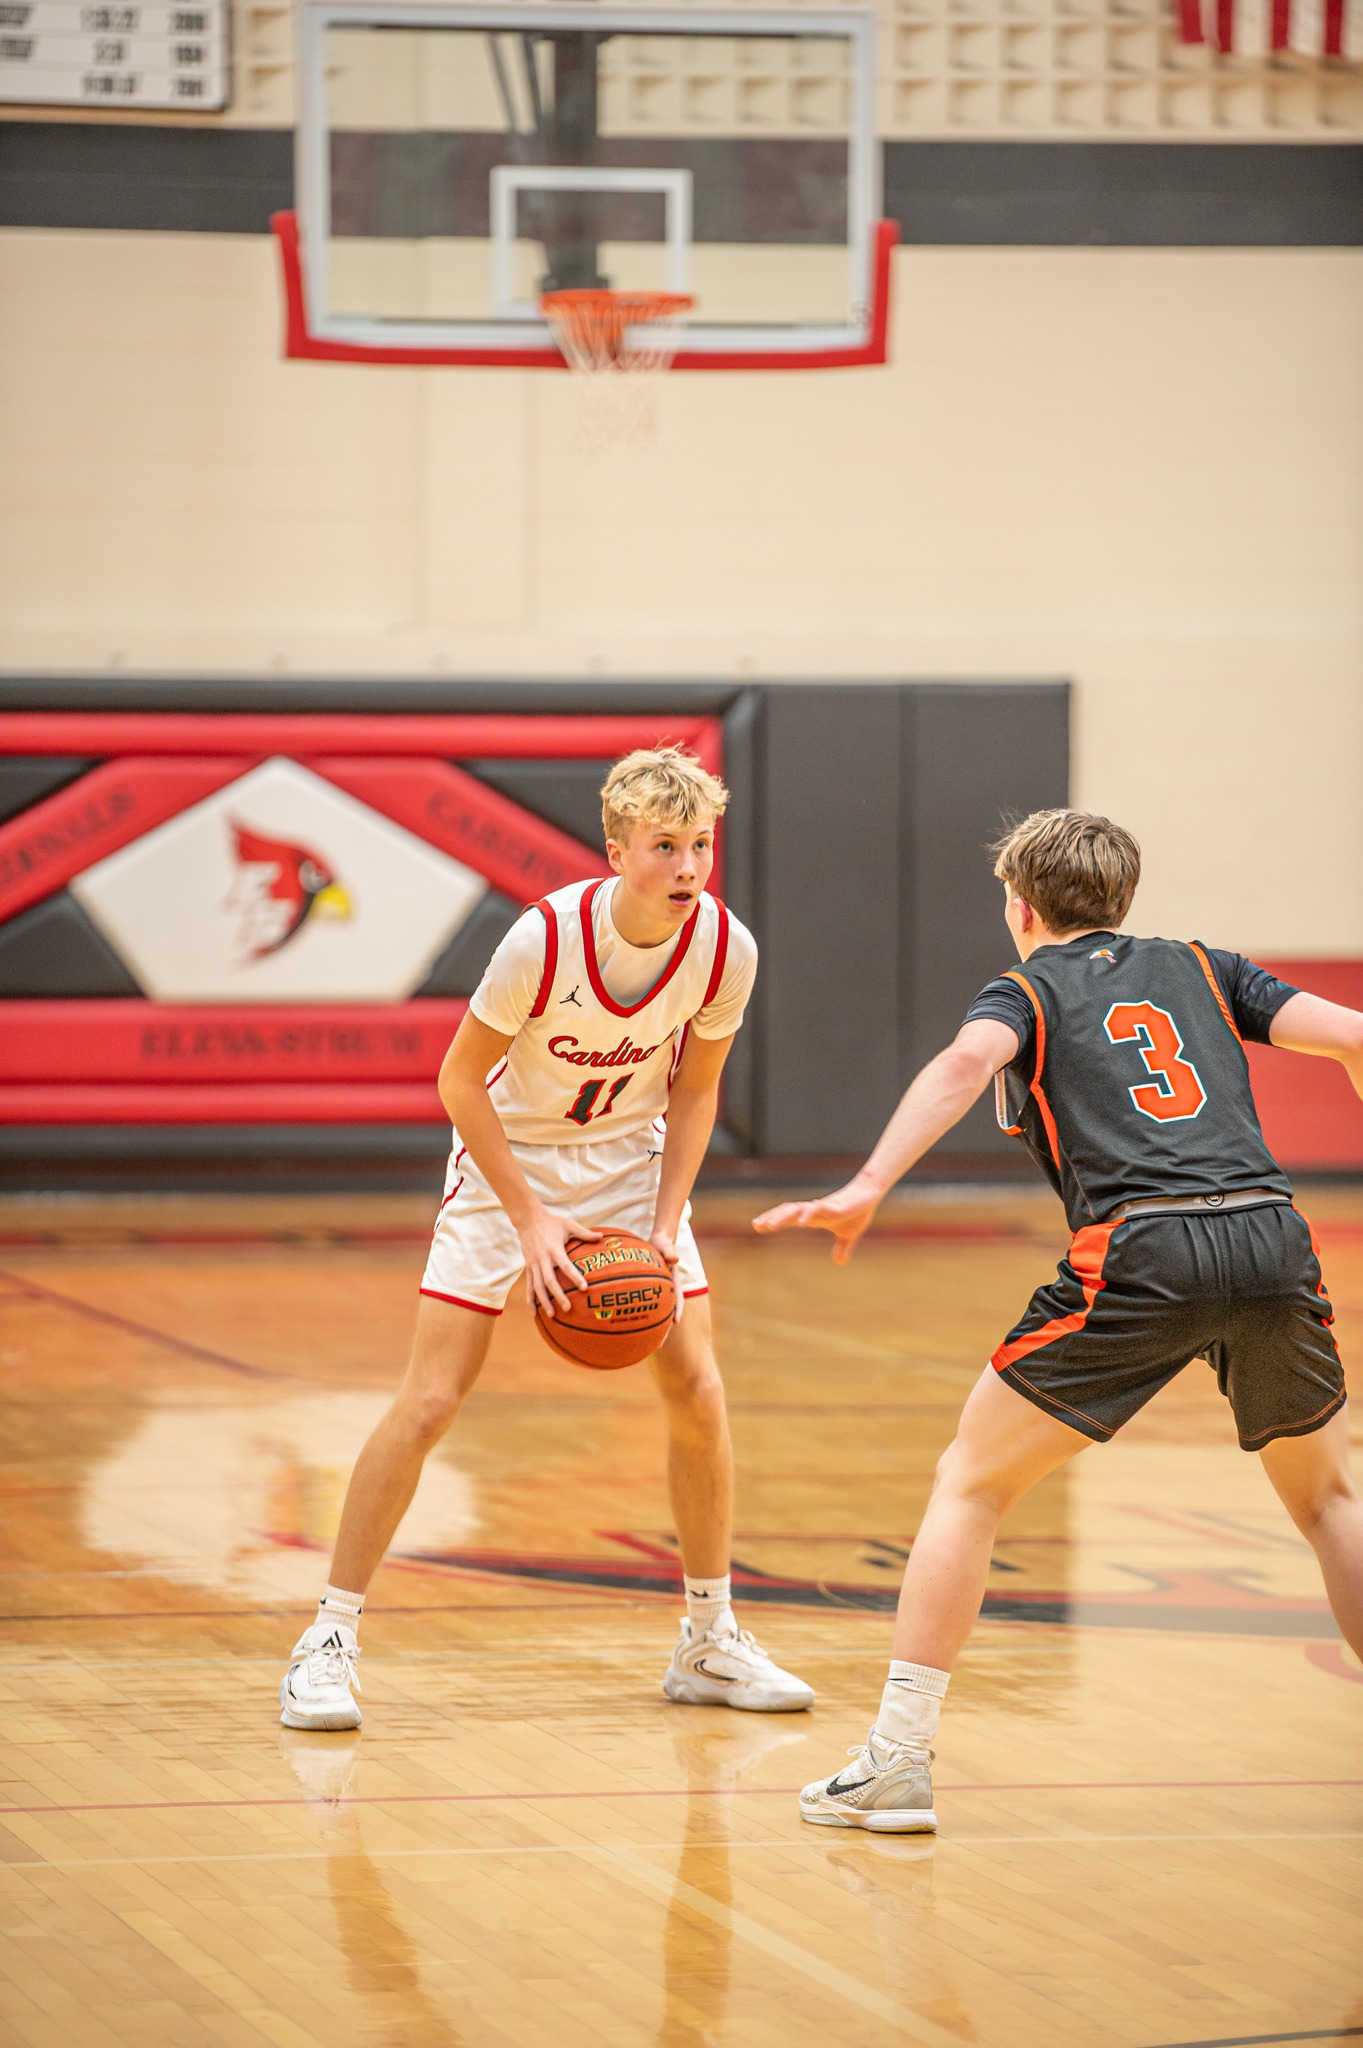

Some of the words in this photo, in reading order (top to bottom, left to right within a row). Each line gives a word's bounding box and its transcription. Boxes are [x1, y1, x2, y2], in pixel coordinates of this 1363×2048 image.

[1103, 1000, 1207, 1123] 3
[564, 1072, 635, 1126] 11
[586, 1285, 662, 1309] LEGACY
[616, 1302, 659, 1316] 1000
